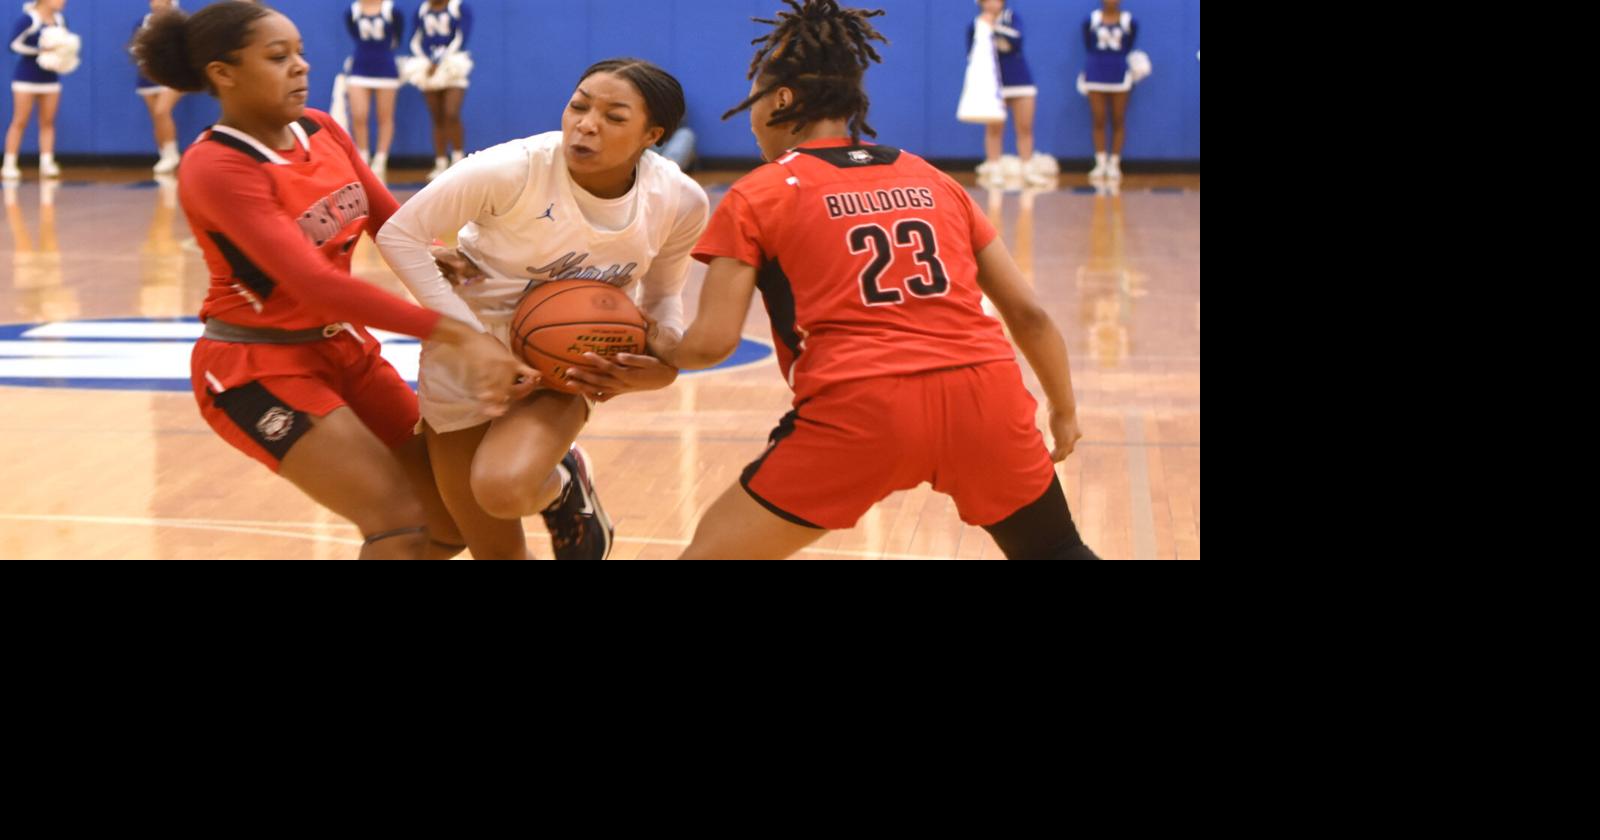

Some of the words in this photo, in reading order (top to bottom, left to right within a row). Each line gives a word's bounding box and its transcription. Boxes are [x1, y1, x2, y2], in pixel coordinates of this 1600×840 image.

[358, 17, 384, 40] N
[423, 12, 450, 36] N
[1096, 26, 1122, 51] N
[824, 187, 935, 219] BULLDOGS
[846, 218, 949, 307] 23
